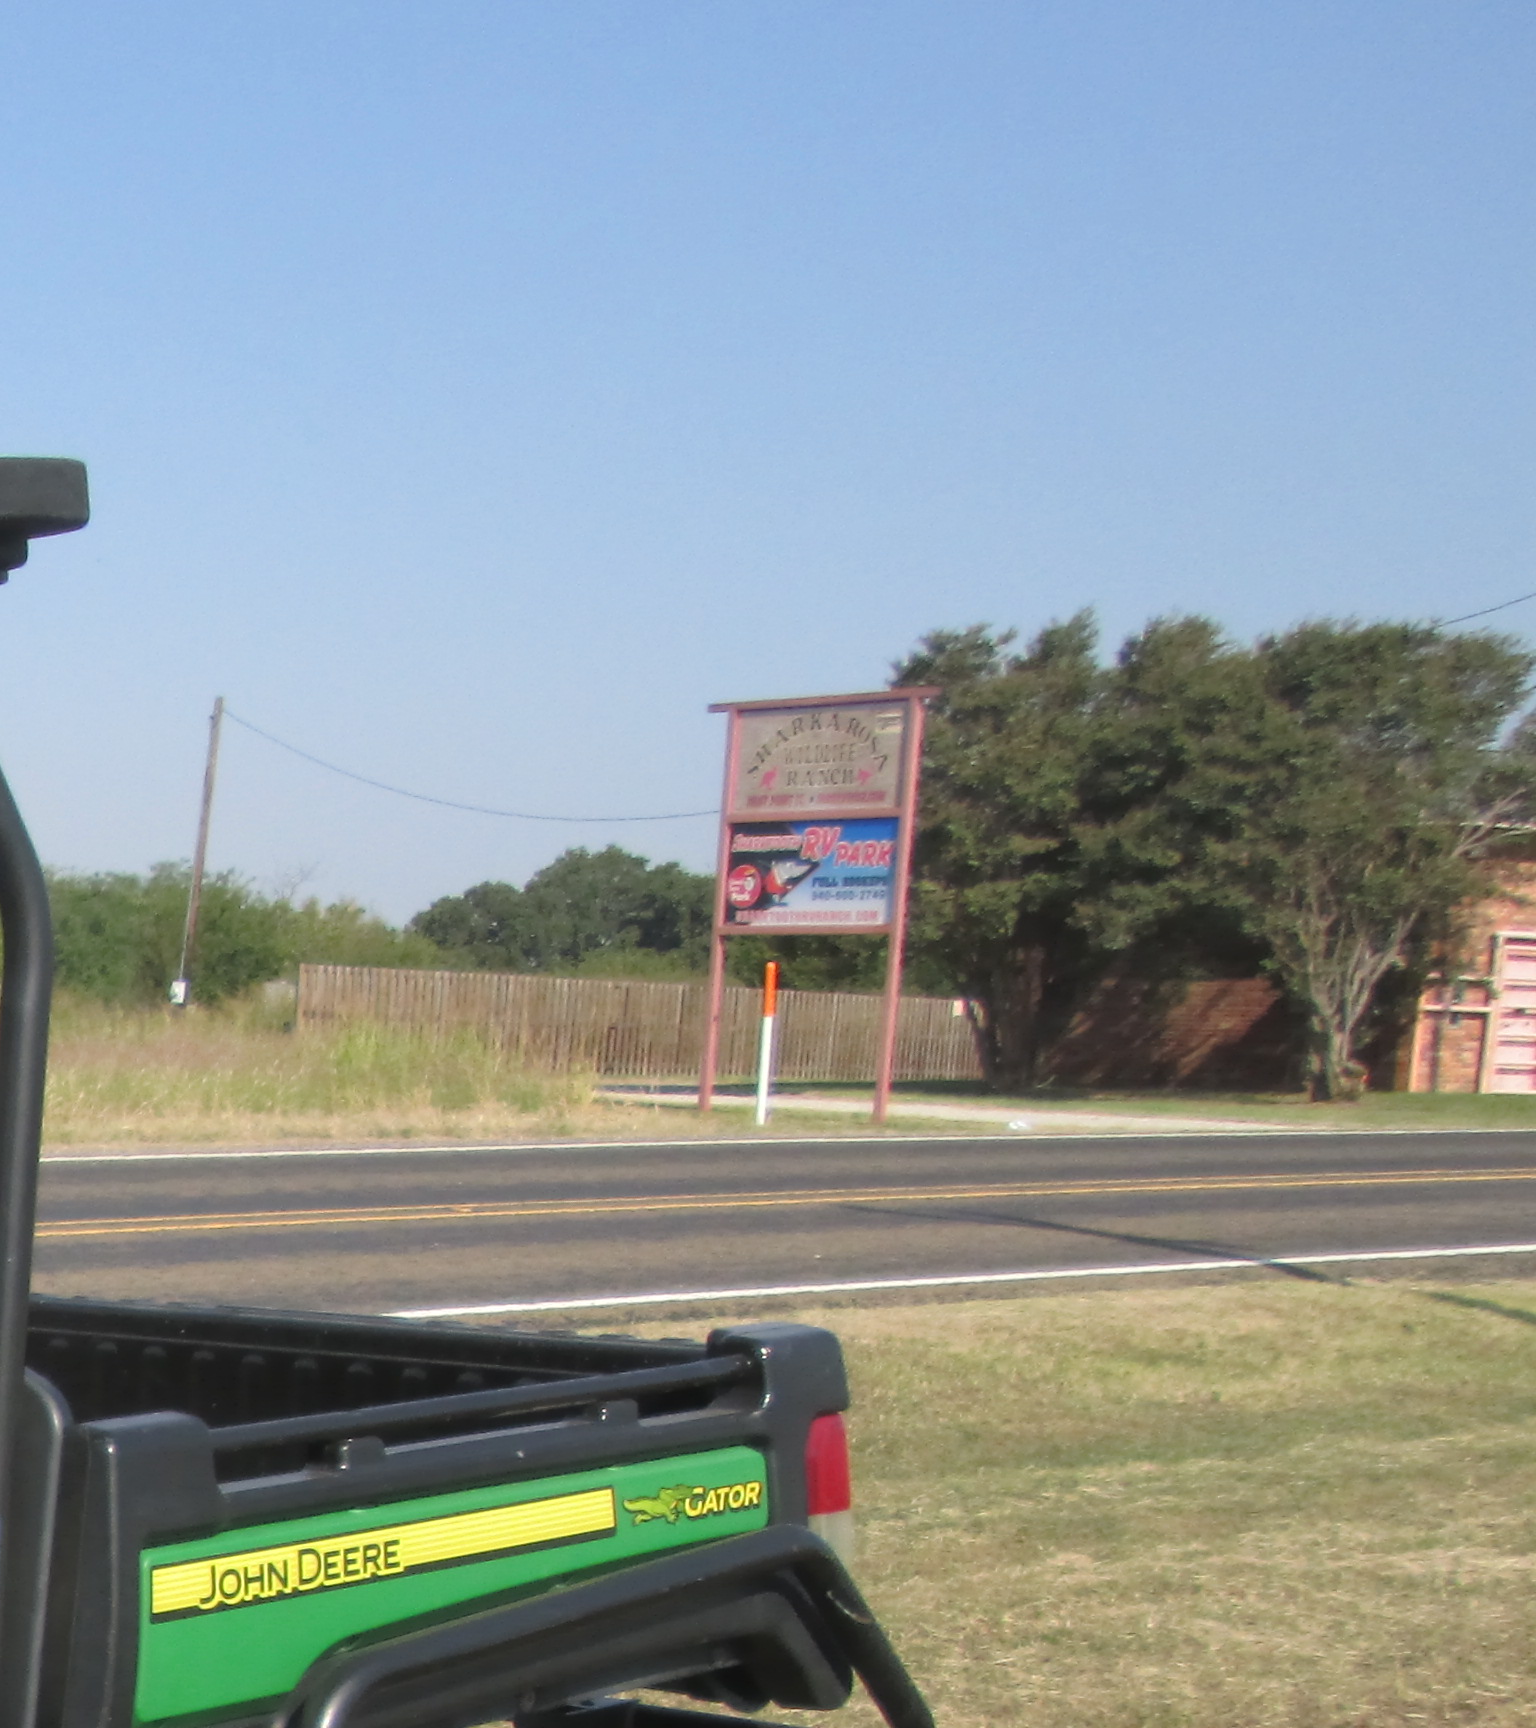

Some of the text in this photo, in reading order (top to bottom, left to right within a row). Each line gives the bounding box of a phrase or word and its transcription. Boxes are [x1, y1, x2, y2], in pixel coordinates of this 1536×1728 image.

[786, 769, 854, 787] RANCH
[801, 827, 842, 861] RV
[835, 841, 894, 867] PARK
[684, 1481, 762, 1518] GATOR
[199, 1539, 401, 1605] JOHN DEERE
